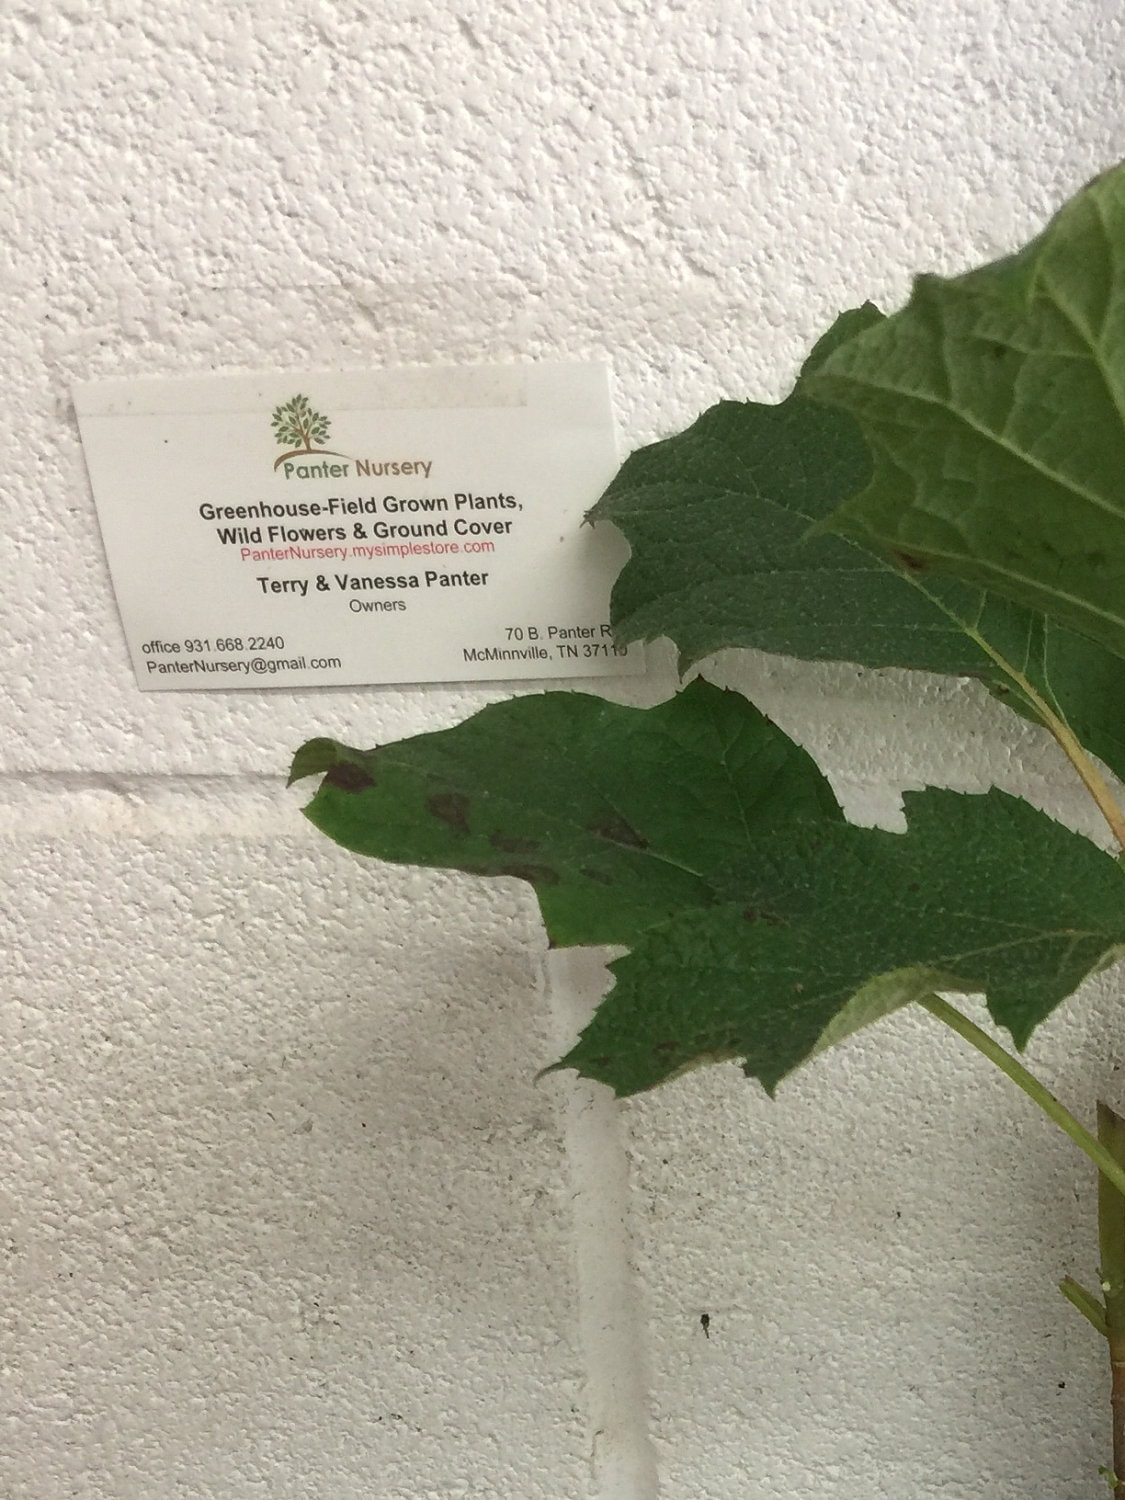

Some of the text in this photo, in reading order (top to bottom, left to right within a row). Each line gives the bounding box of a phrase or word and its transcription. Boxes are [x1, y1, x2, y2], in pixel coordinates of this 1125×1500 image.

[284, 458, 432, 480] Panter Nursery
[199, 492, 523, 520] Greenhouse-Field Grown Plants,
[216, 518, 513, 545] Wild Flowers & Ground Cover
[240, 540, 496, 562] PanterNursery.mysimplestore.com
[256, 570, 489, 597] Terry & Vanessa Panter
[349, 598, 407, 613] Owners
[504, 627, 524, 641] 70
[528, 626, 545, 641] B.
[547, 624, 596, 640] Panter
[141, 635, 285, 655] office 931.668.2240
[462, 645, 554, 662] McMinnville,
[556, 645, 580, 659] TN
[146, 656, 342, 675] PanterNursery@gmail.com
